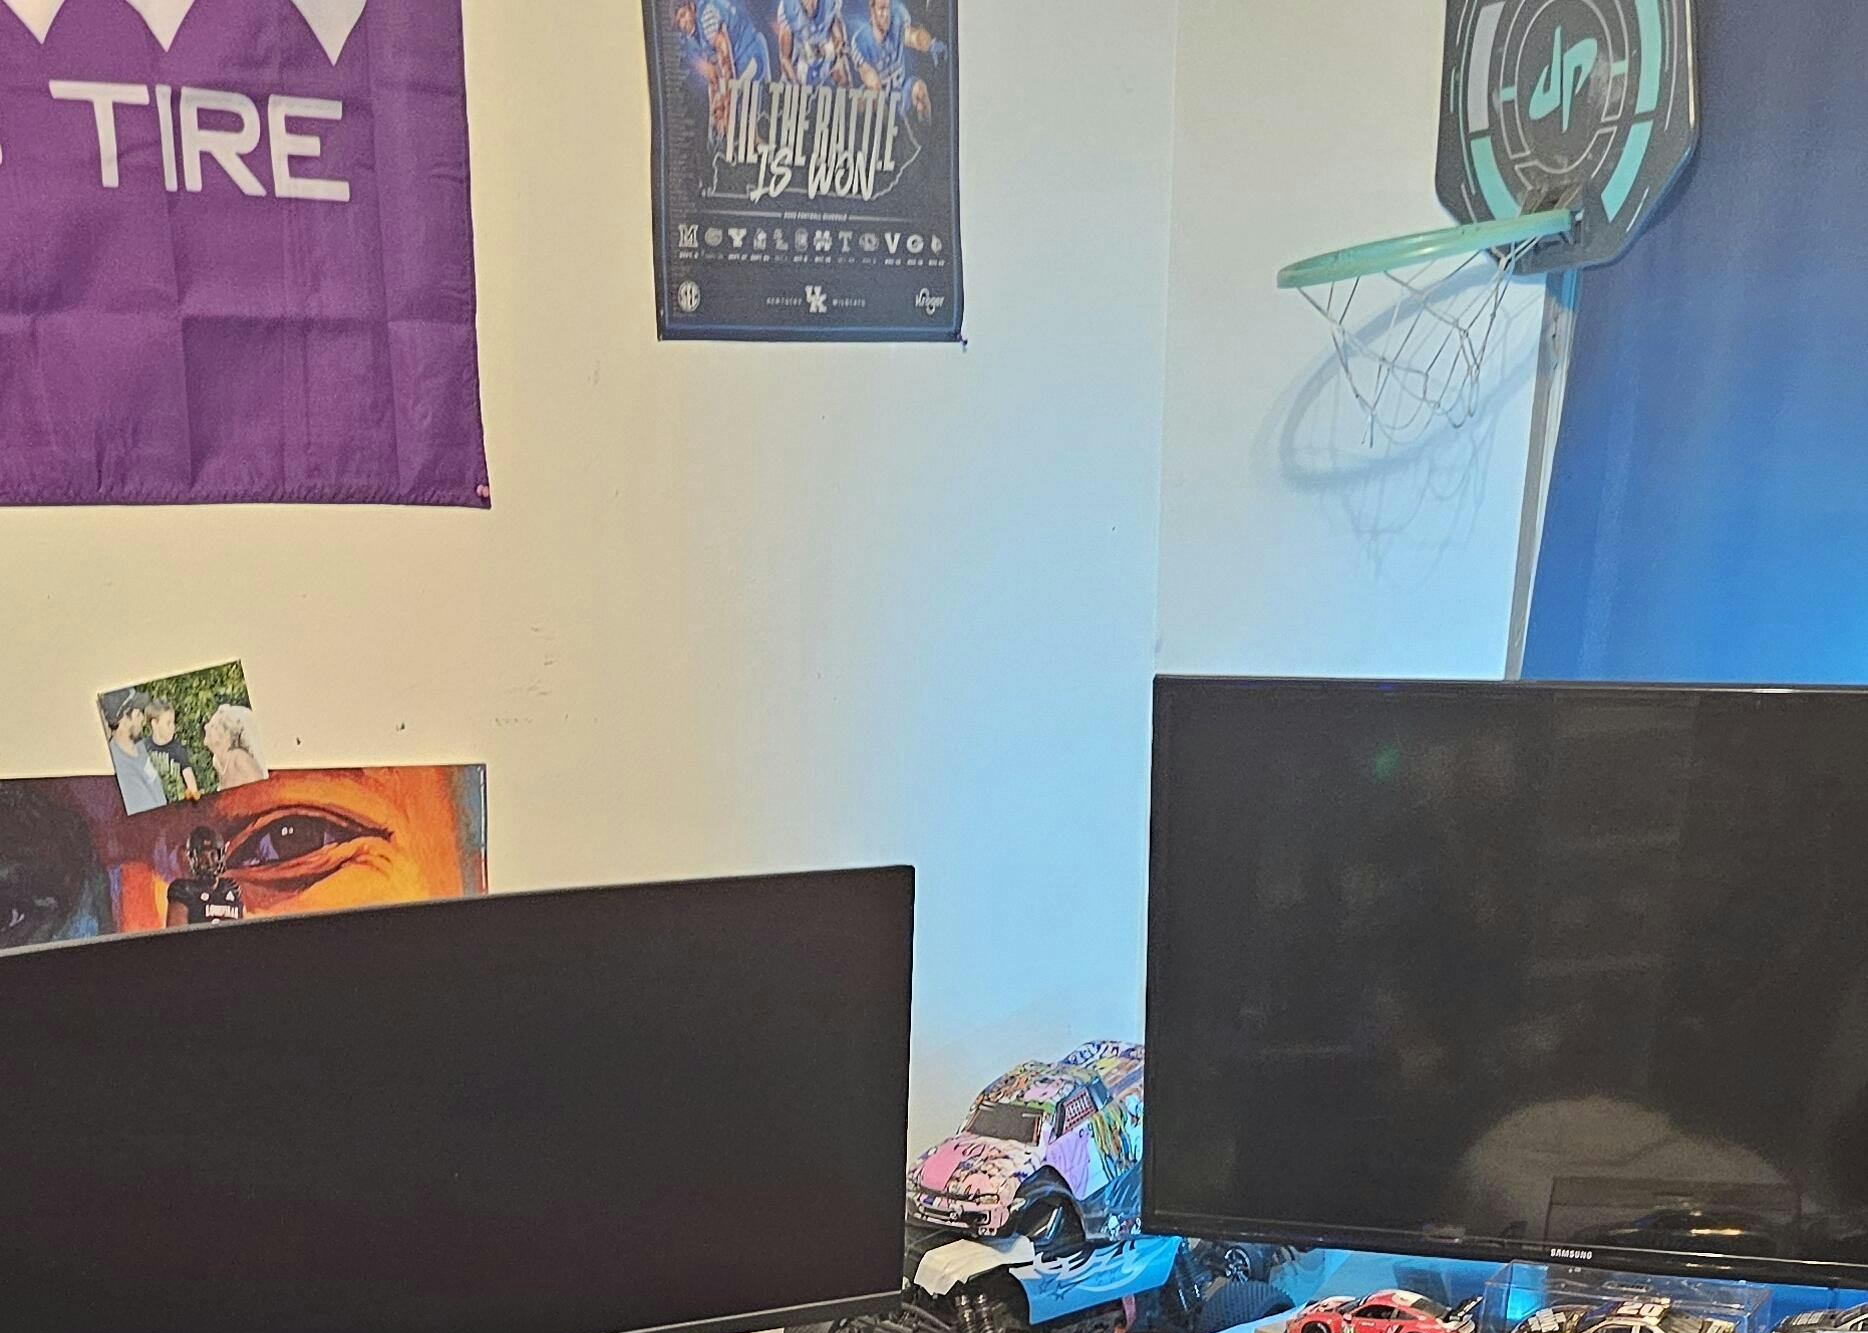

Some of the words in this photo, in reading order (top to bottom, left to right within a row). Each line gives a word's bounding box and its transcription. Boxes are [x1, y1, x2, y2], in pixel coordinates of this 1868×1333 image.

[49, 80, 350, 202] TIRE
[750, 144, 793, 204] IS
[808, 149, 877, 201] WON
[1550, 1248, 1593, 1260] SAMSUNG
[1617, 1301, 1664, 1317] 20
